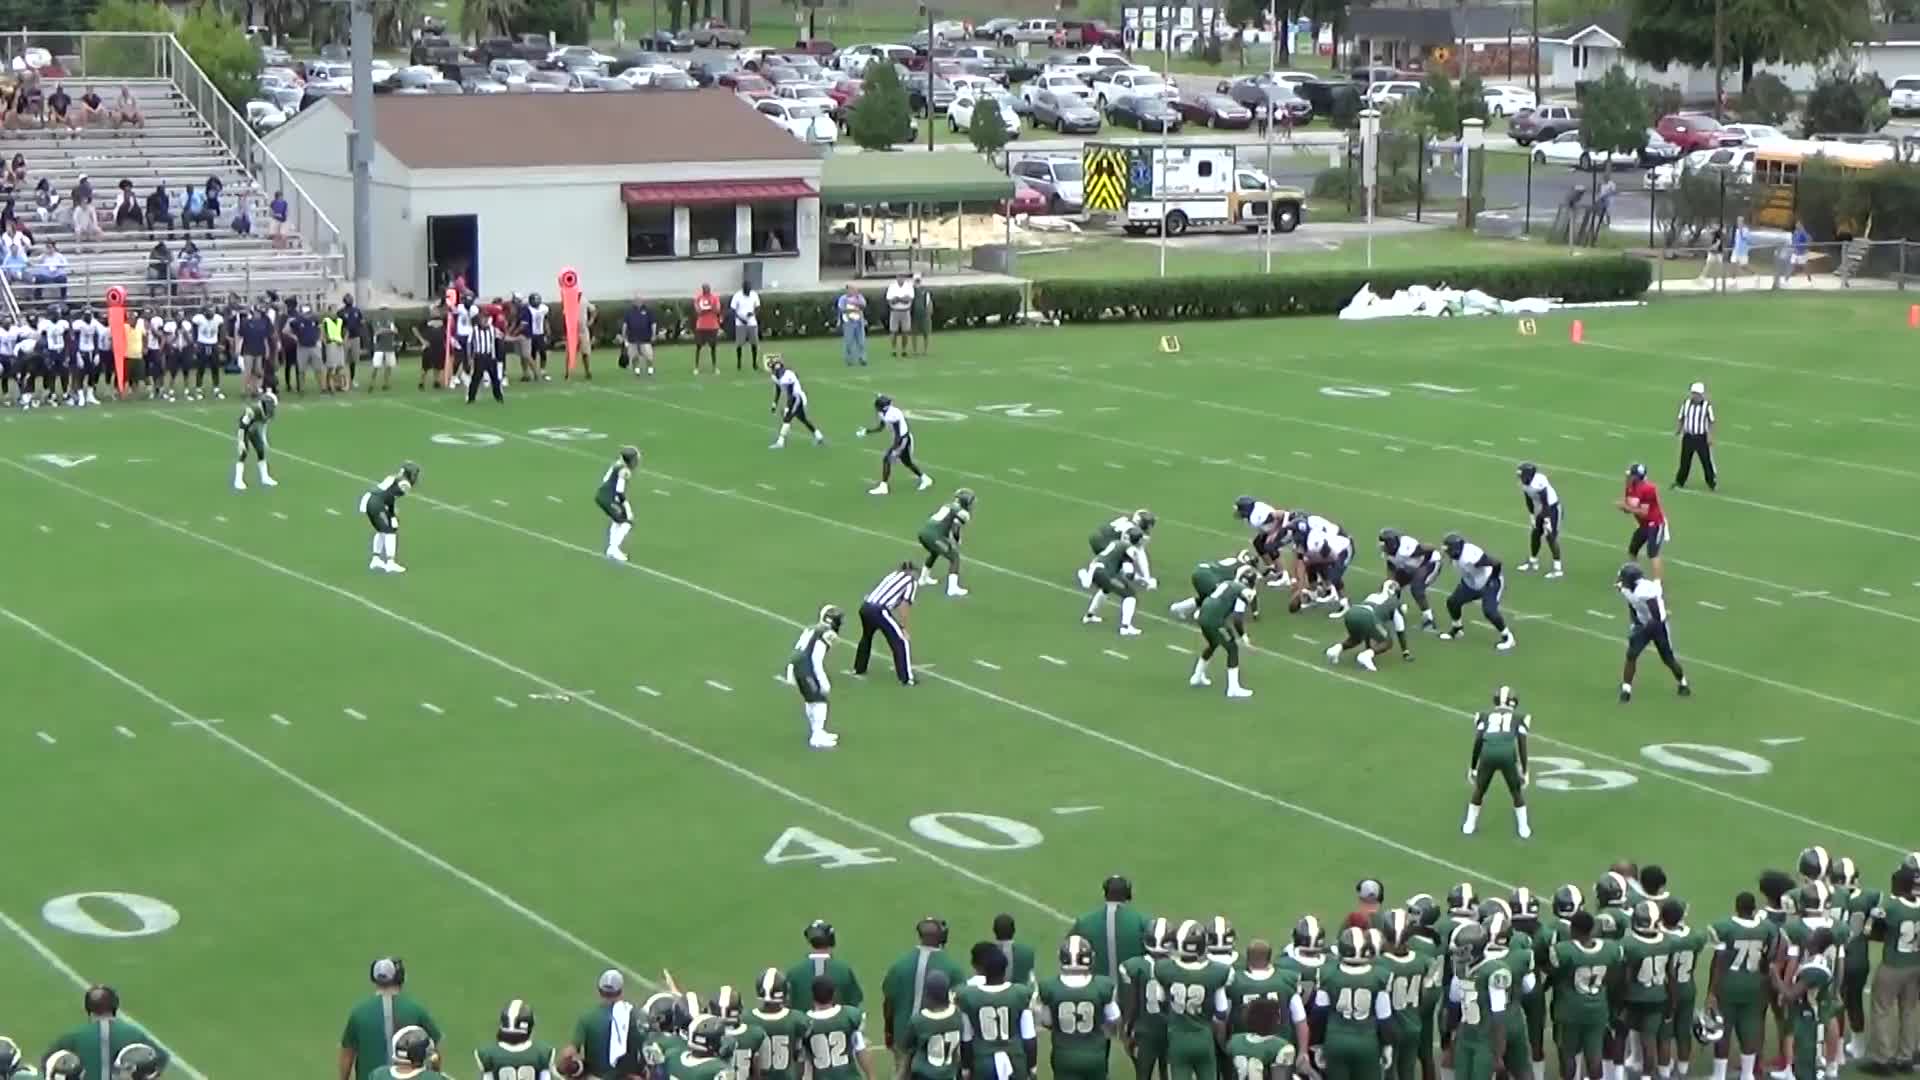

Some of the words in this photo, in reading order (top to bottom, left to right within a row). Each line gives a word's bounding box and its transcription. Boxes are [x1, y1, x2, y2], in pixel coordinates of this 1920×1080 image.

[1528, 743, 1774, 791] 30
[764, 812, 1044, 869] 40
[979, 1006, 1009, 1041] 61
